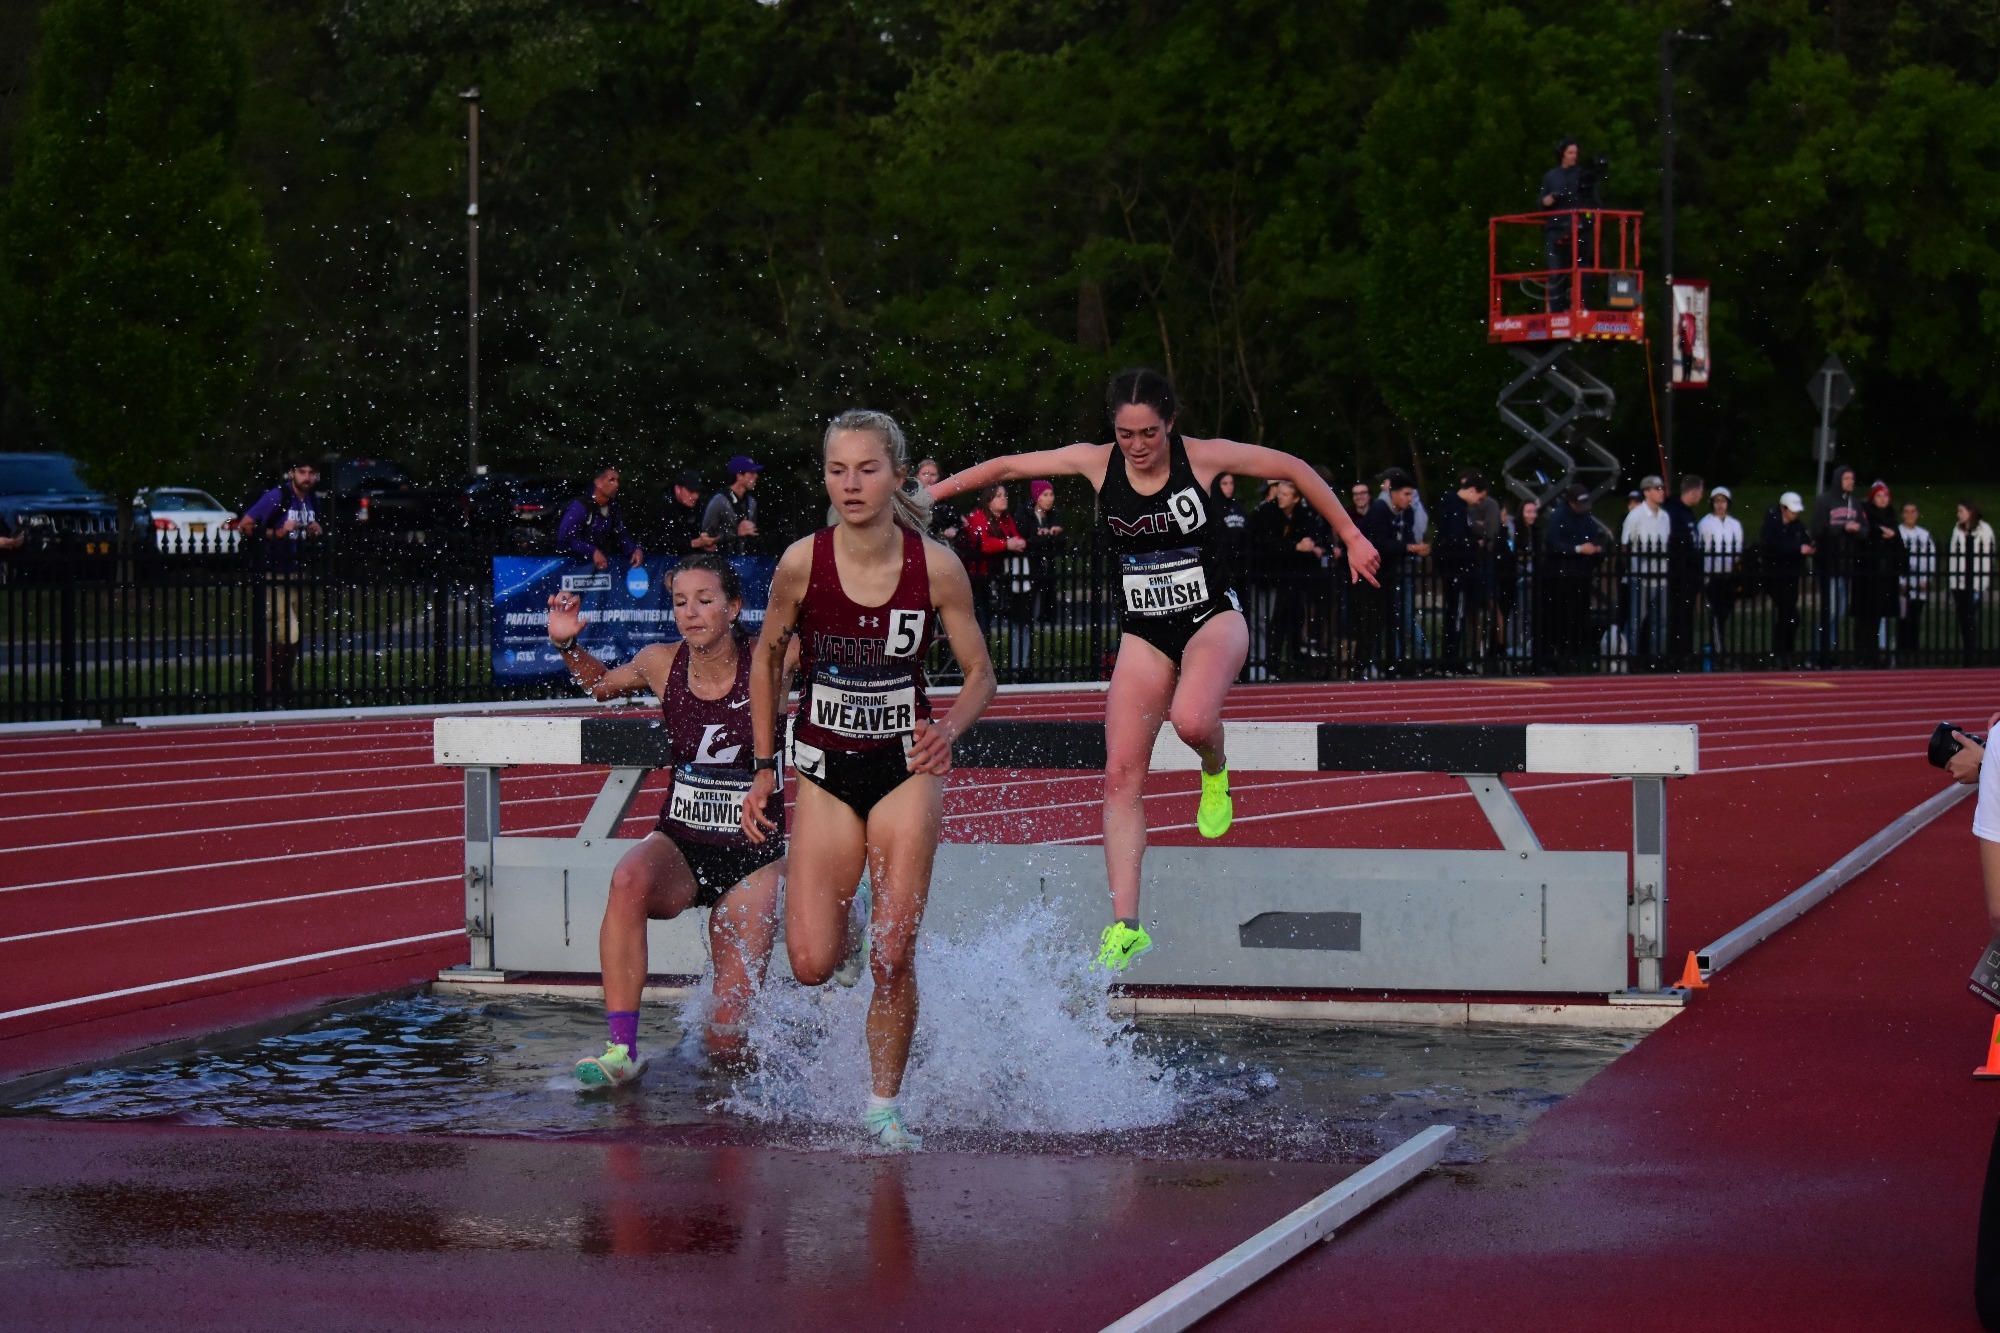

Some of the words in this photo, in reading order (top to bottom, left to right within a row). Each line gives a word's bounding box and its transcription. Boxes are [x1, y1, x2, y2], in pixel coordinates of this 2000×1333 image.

[1108, 512, 1177, 536] MI
[1176, 495, 1199, 531] 9
[1149, 575, 1173, 586] EINAT
[1130, 580, 1202, 609] GAVISH
[602, 609, 661, 622] OPPORTUNITIES
[894, 613, 919, 655] 5
[828, 675, 846, 685] TRACK
[867, 674, 912, 687] CHAMPIONSHIPS
[841, 693, 888, 707] CORRINE
[816, 699, 911, 732] WEAVER
[693, 790, 732, 802] KATELYN
[673, 796, 742, 826] CHADWIC
